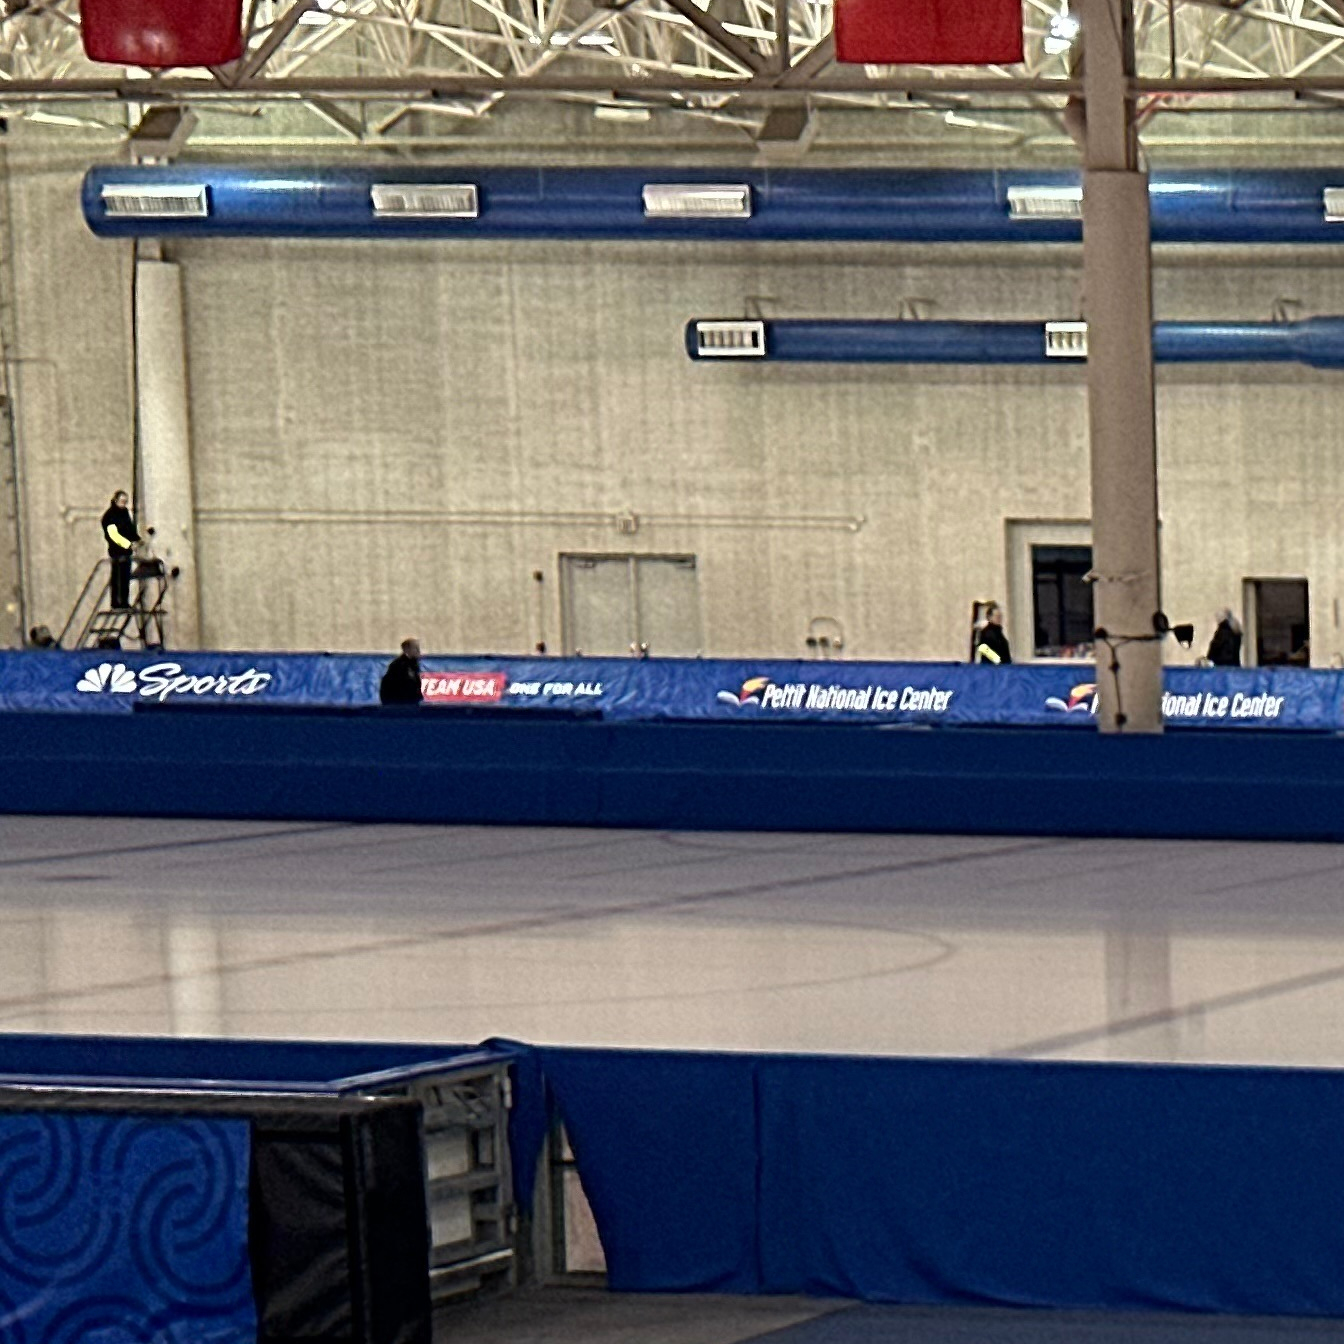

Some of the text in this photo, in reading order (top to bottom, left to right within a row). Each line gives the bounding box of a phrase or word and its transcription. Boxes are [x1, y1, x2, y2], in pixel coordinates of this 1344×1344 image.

[138, 662, 272, 702] Sports
[462, 679, 496, 696] USA
[575, 682, 603, 696] ALL
[805, 685, 872, 711] National
[871, 686, 898, 711] Ice
[899, 686, 954, 712] Center
[1202, 692, 1229, 718] Ice
[1230, 692, 1285, 718] Center
